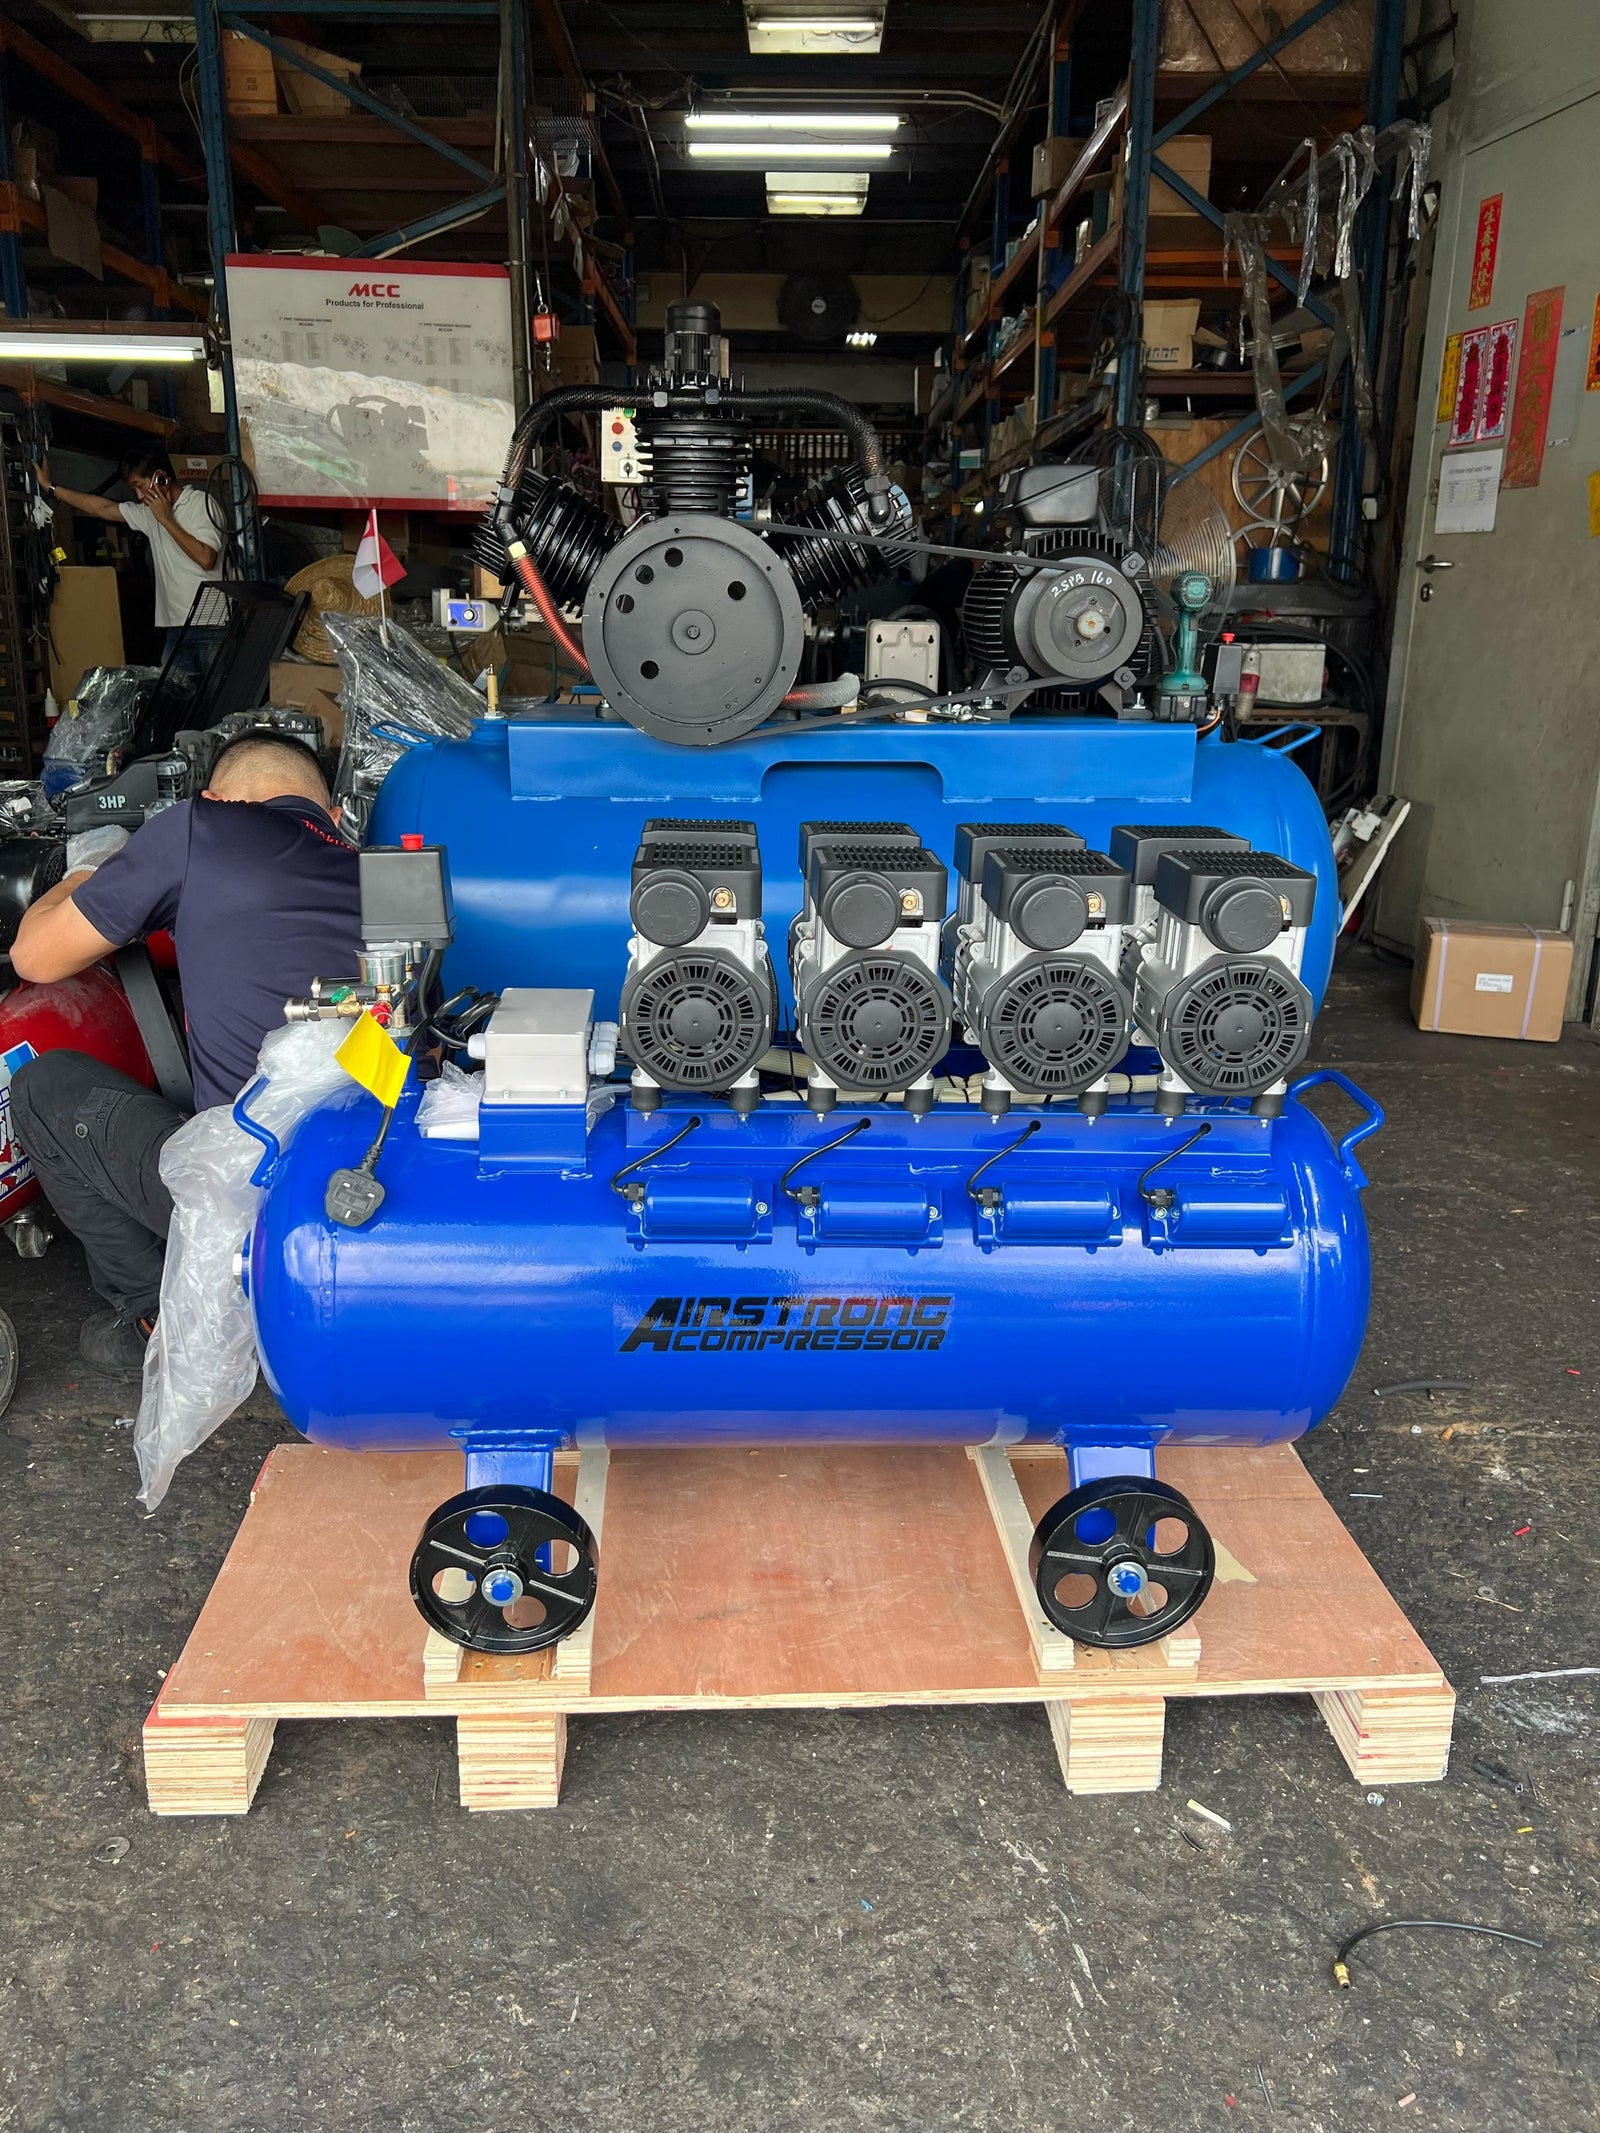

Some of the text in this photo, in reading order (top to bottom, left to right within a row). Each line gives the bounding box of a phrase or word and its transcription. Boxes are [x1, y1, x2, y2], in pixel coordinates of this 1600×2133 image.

[348, 283, 401, 298] MCC
[325, 298, 424, 310] Products for Professional
[1090, 570, 1113, 586] 160
[98, 795, 126, 809] 3HP
[618, 1295, 954, 1352] AIRSTRONG
[672, 1329, 949, 1351] COMPRESSOR
